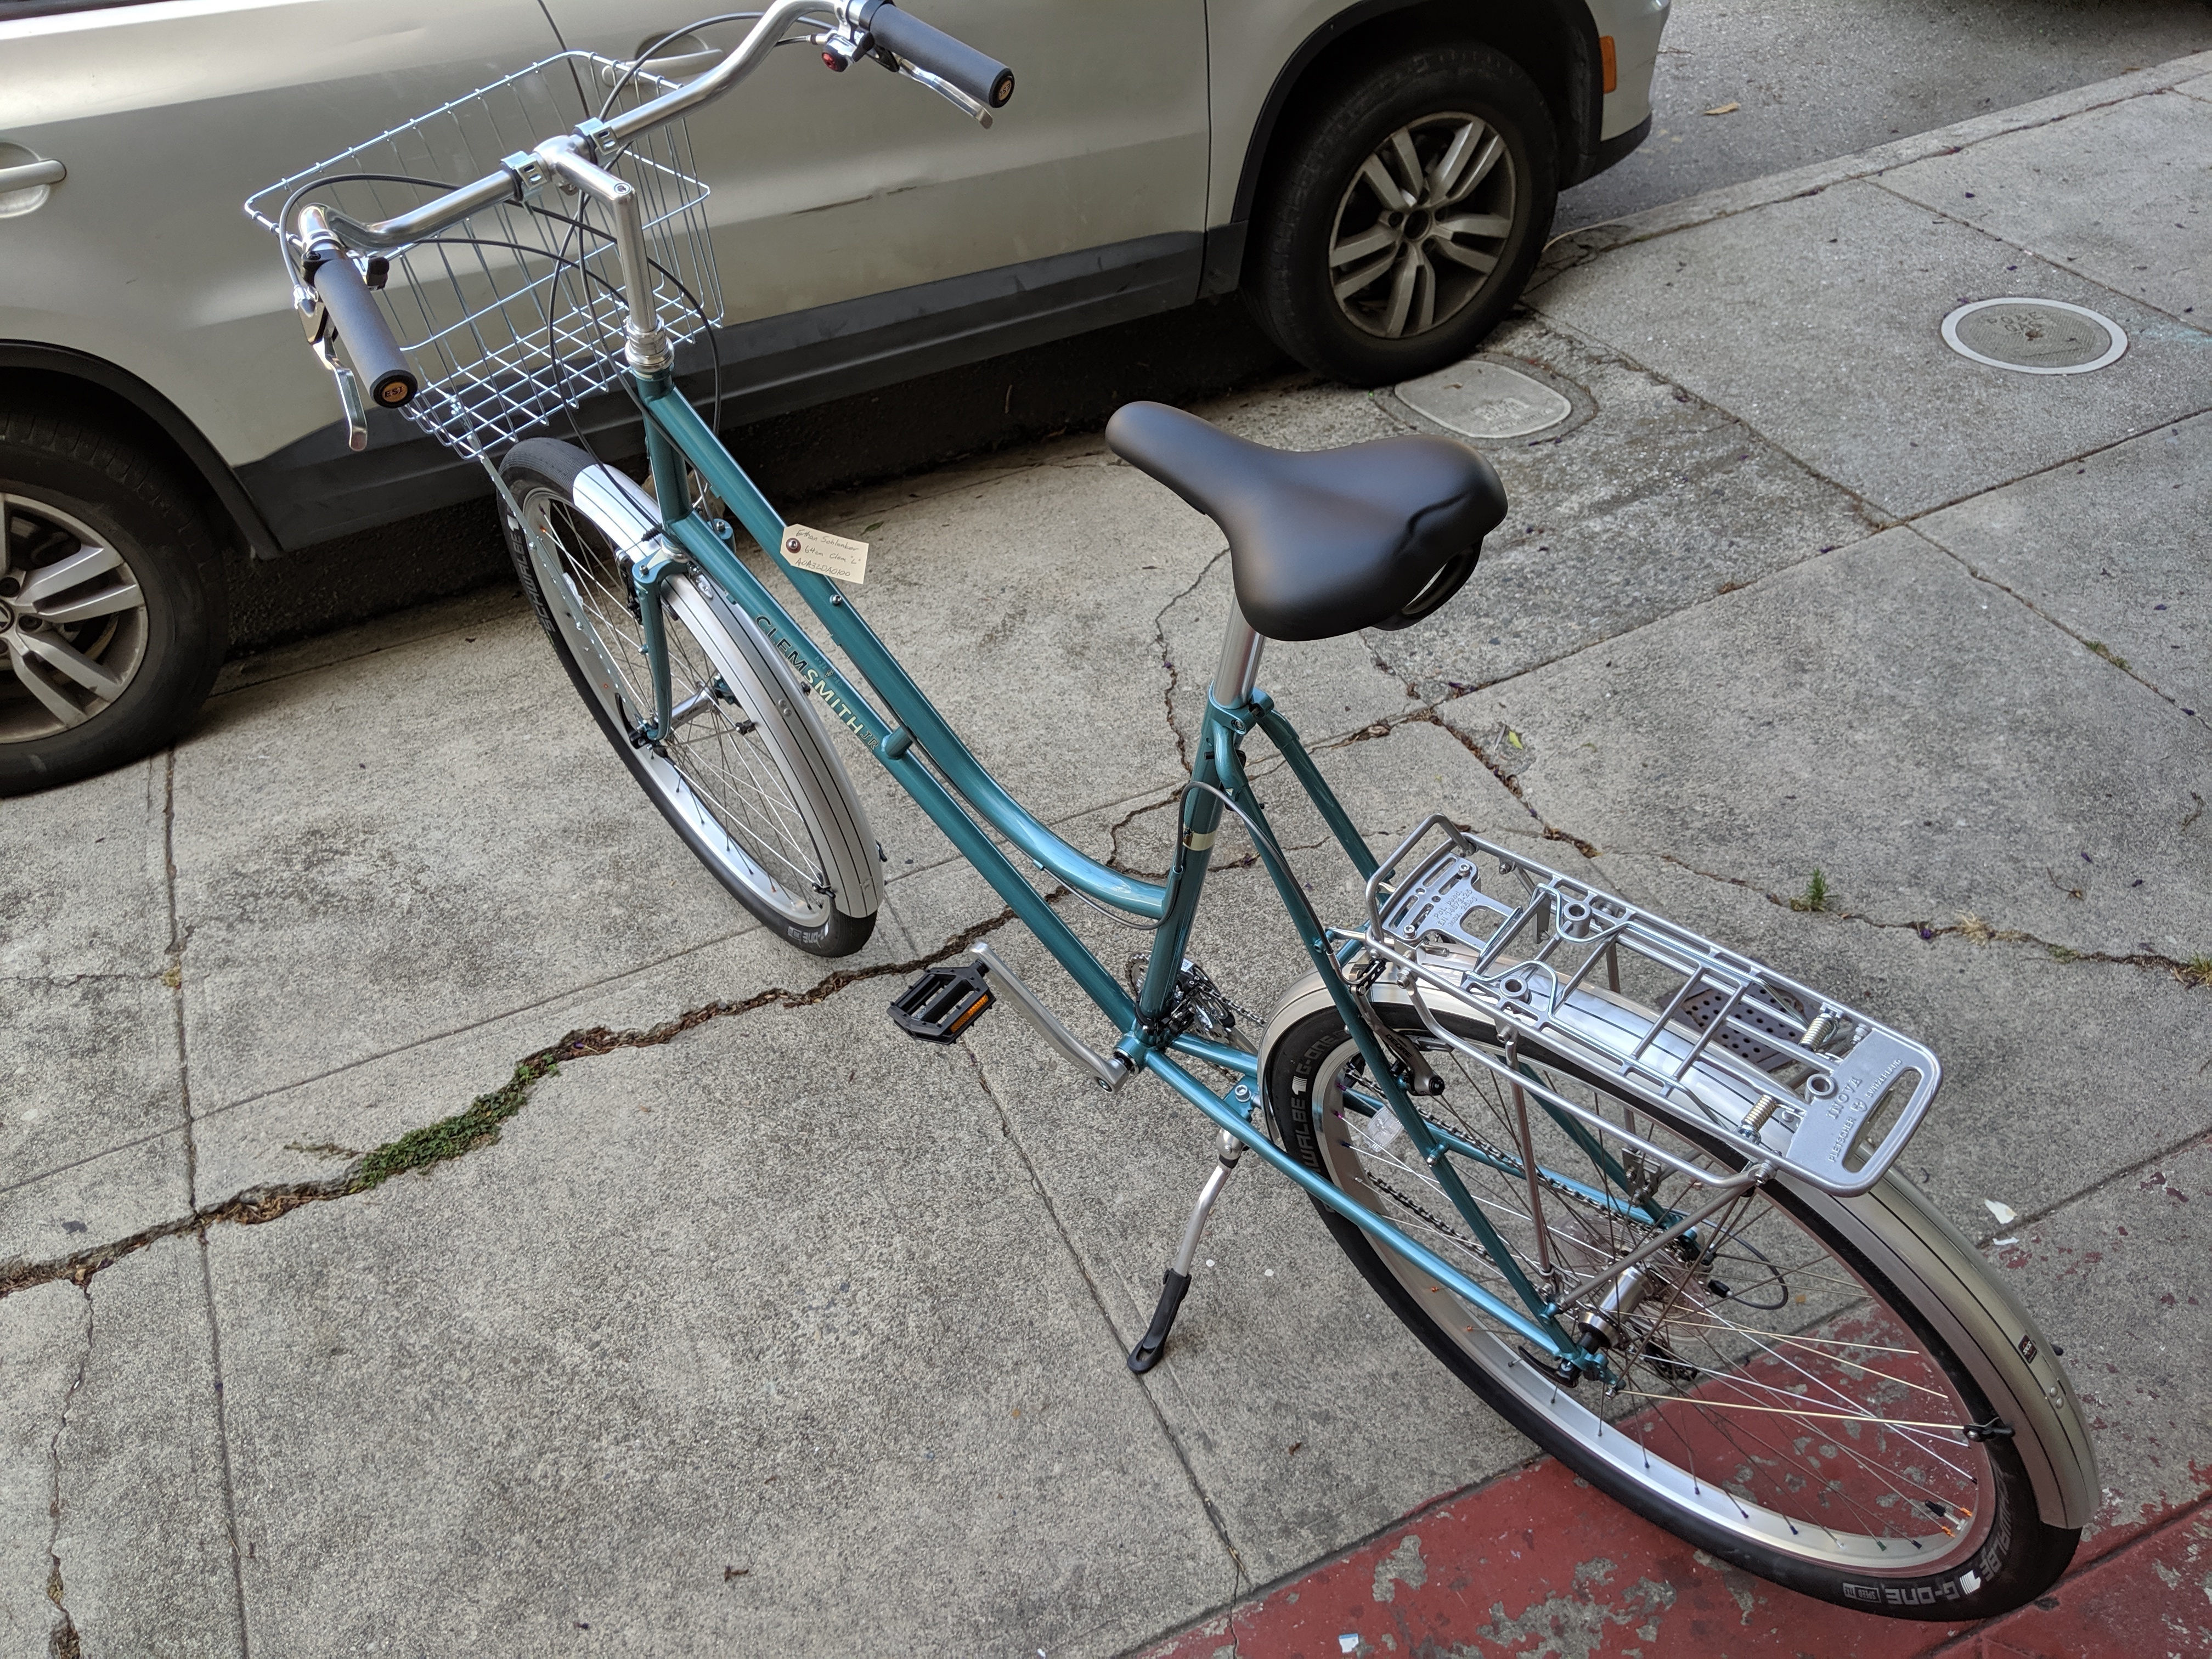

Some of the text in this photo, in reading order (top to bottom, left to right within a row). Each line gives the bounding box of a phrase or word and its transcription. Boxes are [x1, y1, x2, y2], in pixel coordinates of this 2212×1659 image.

[384, 386, 404, 398] ESI
[510, 532, 556, 633] SCHWALBE
[1295, 1035, 1336, 1075] G-ONE
[1385, 1034, 1414, 1058] DEORE
[1826, 1076, 1863, 1120] INOVA
[1827, 1058, 1902, 1163] PLETSCHER SWITZERLAND
[1884, 1581, 1961, 1605] G-ONE
